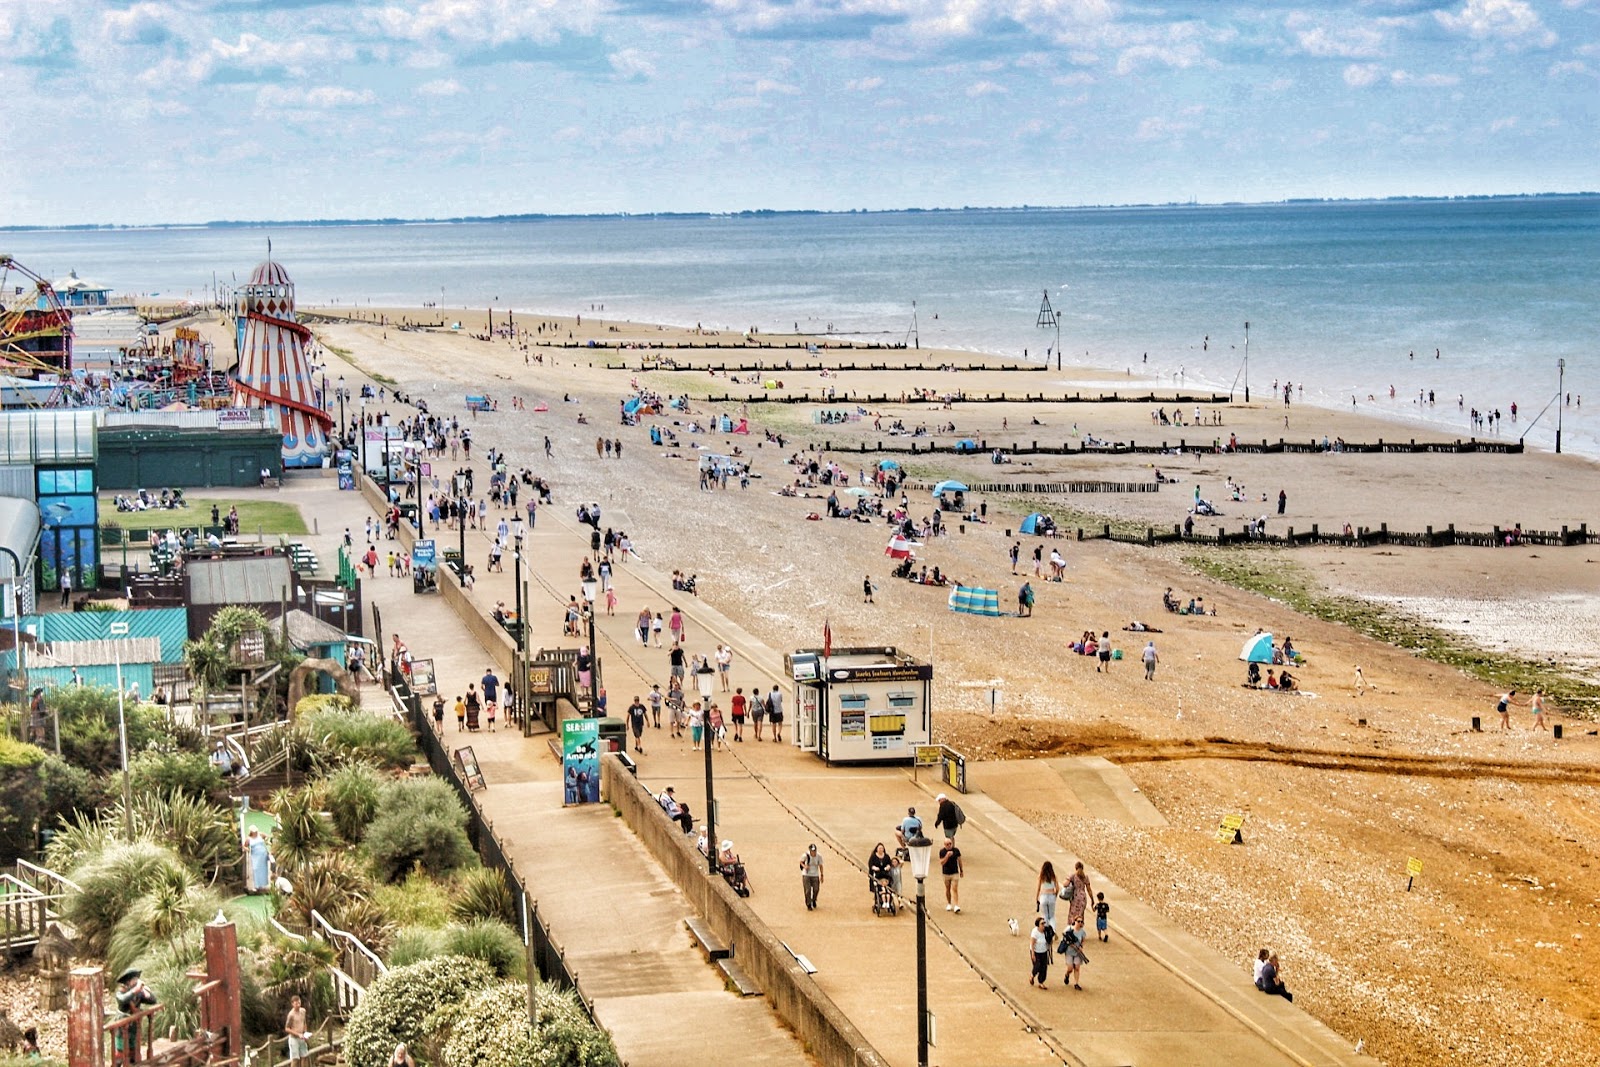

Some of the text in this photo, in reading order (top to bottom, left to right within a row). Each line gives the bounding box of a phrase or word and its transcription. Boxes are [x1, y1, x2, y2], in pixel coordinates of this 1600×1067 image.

[566, 722, 595, 732] SEA LIFE
[576, 745, 586, 753] Be
[566, 751, 597, 760] Amazed
